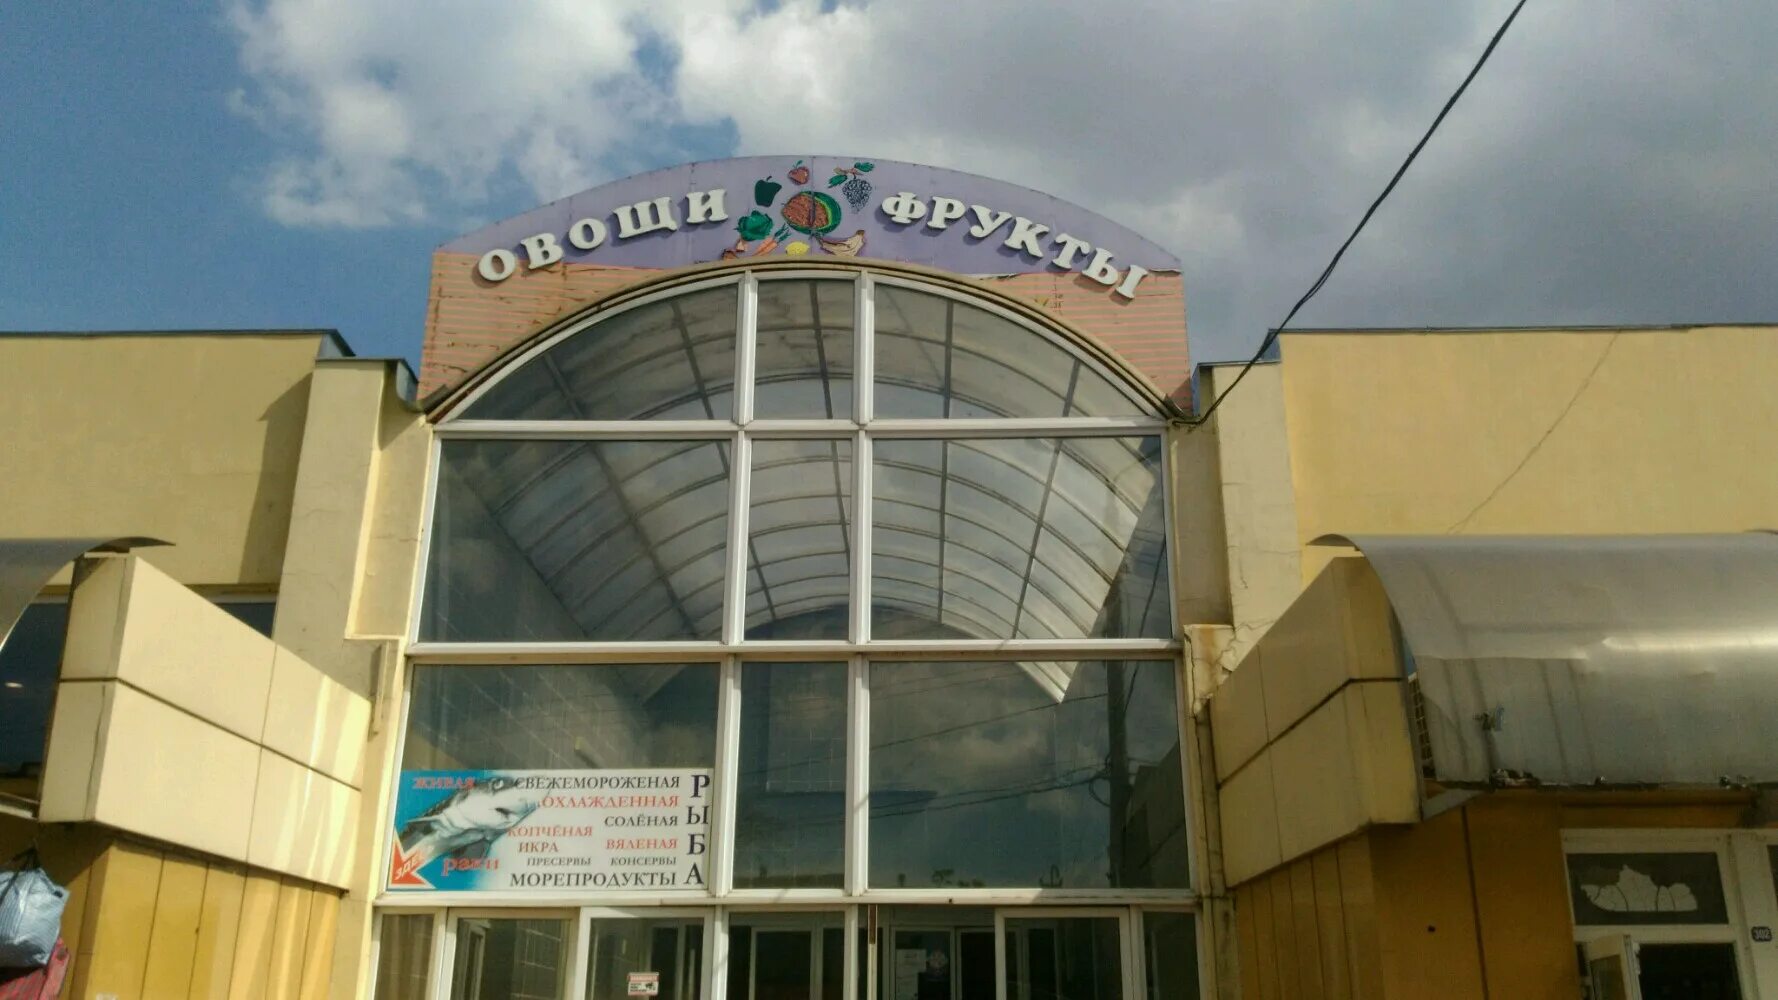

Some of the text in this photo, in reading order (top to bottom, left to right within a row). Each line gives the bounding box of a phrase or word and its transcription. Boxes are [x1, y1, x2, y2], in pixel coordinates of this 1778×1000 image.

[478, 189, 729, 281] ОВОЩИ
[881, 191, 1148, 299] ФРУКТЫ
[515, 776, 680, 790] СВЕЖЕМОРОЖЕНАЯ
[541, 795, 679, 808] ОХЛАЖДЕННАЯ
[604, 813, 678, 827] СОЛЁНАЯ
[683, 774, 711, 885] РЫБА
[519, 841, 559, 853] ИКРА
[606, 839, 678, 850] ВЯЛЕНАЯ
[527, 856, 676, 867] ПРЕСЕРВЫ КОНСЕРВЫ
[510, 872, 676, 888] МОРЕПРОДУКТЫ
